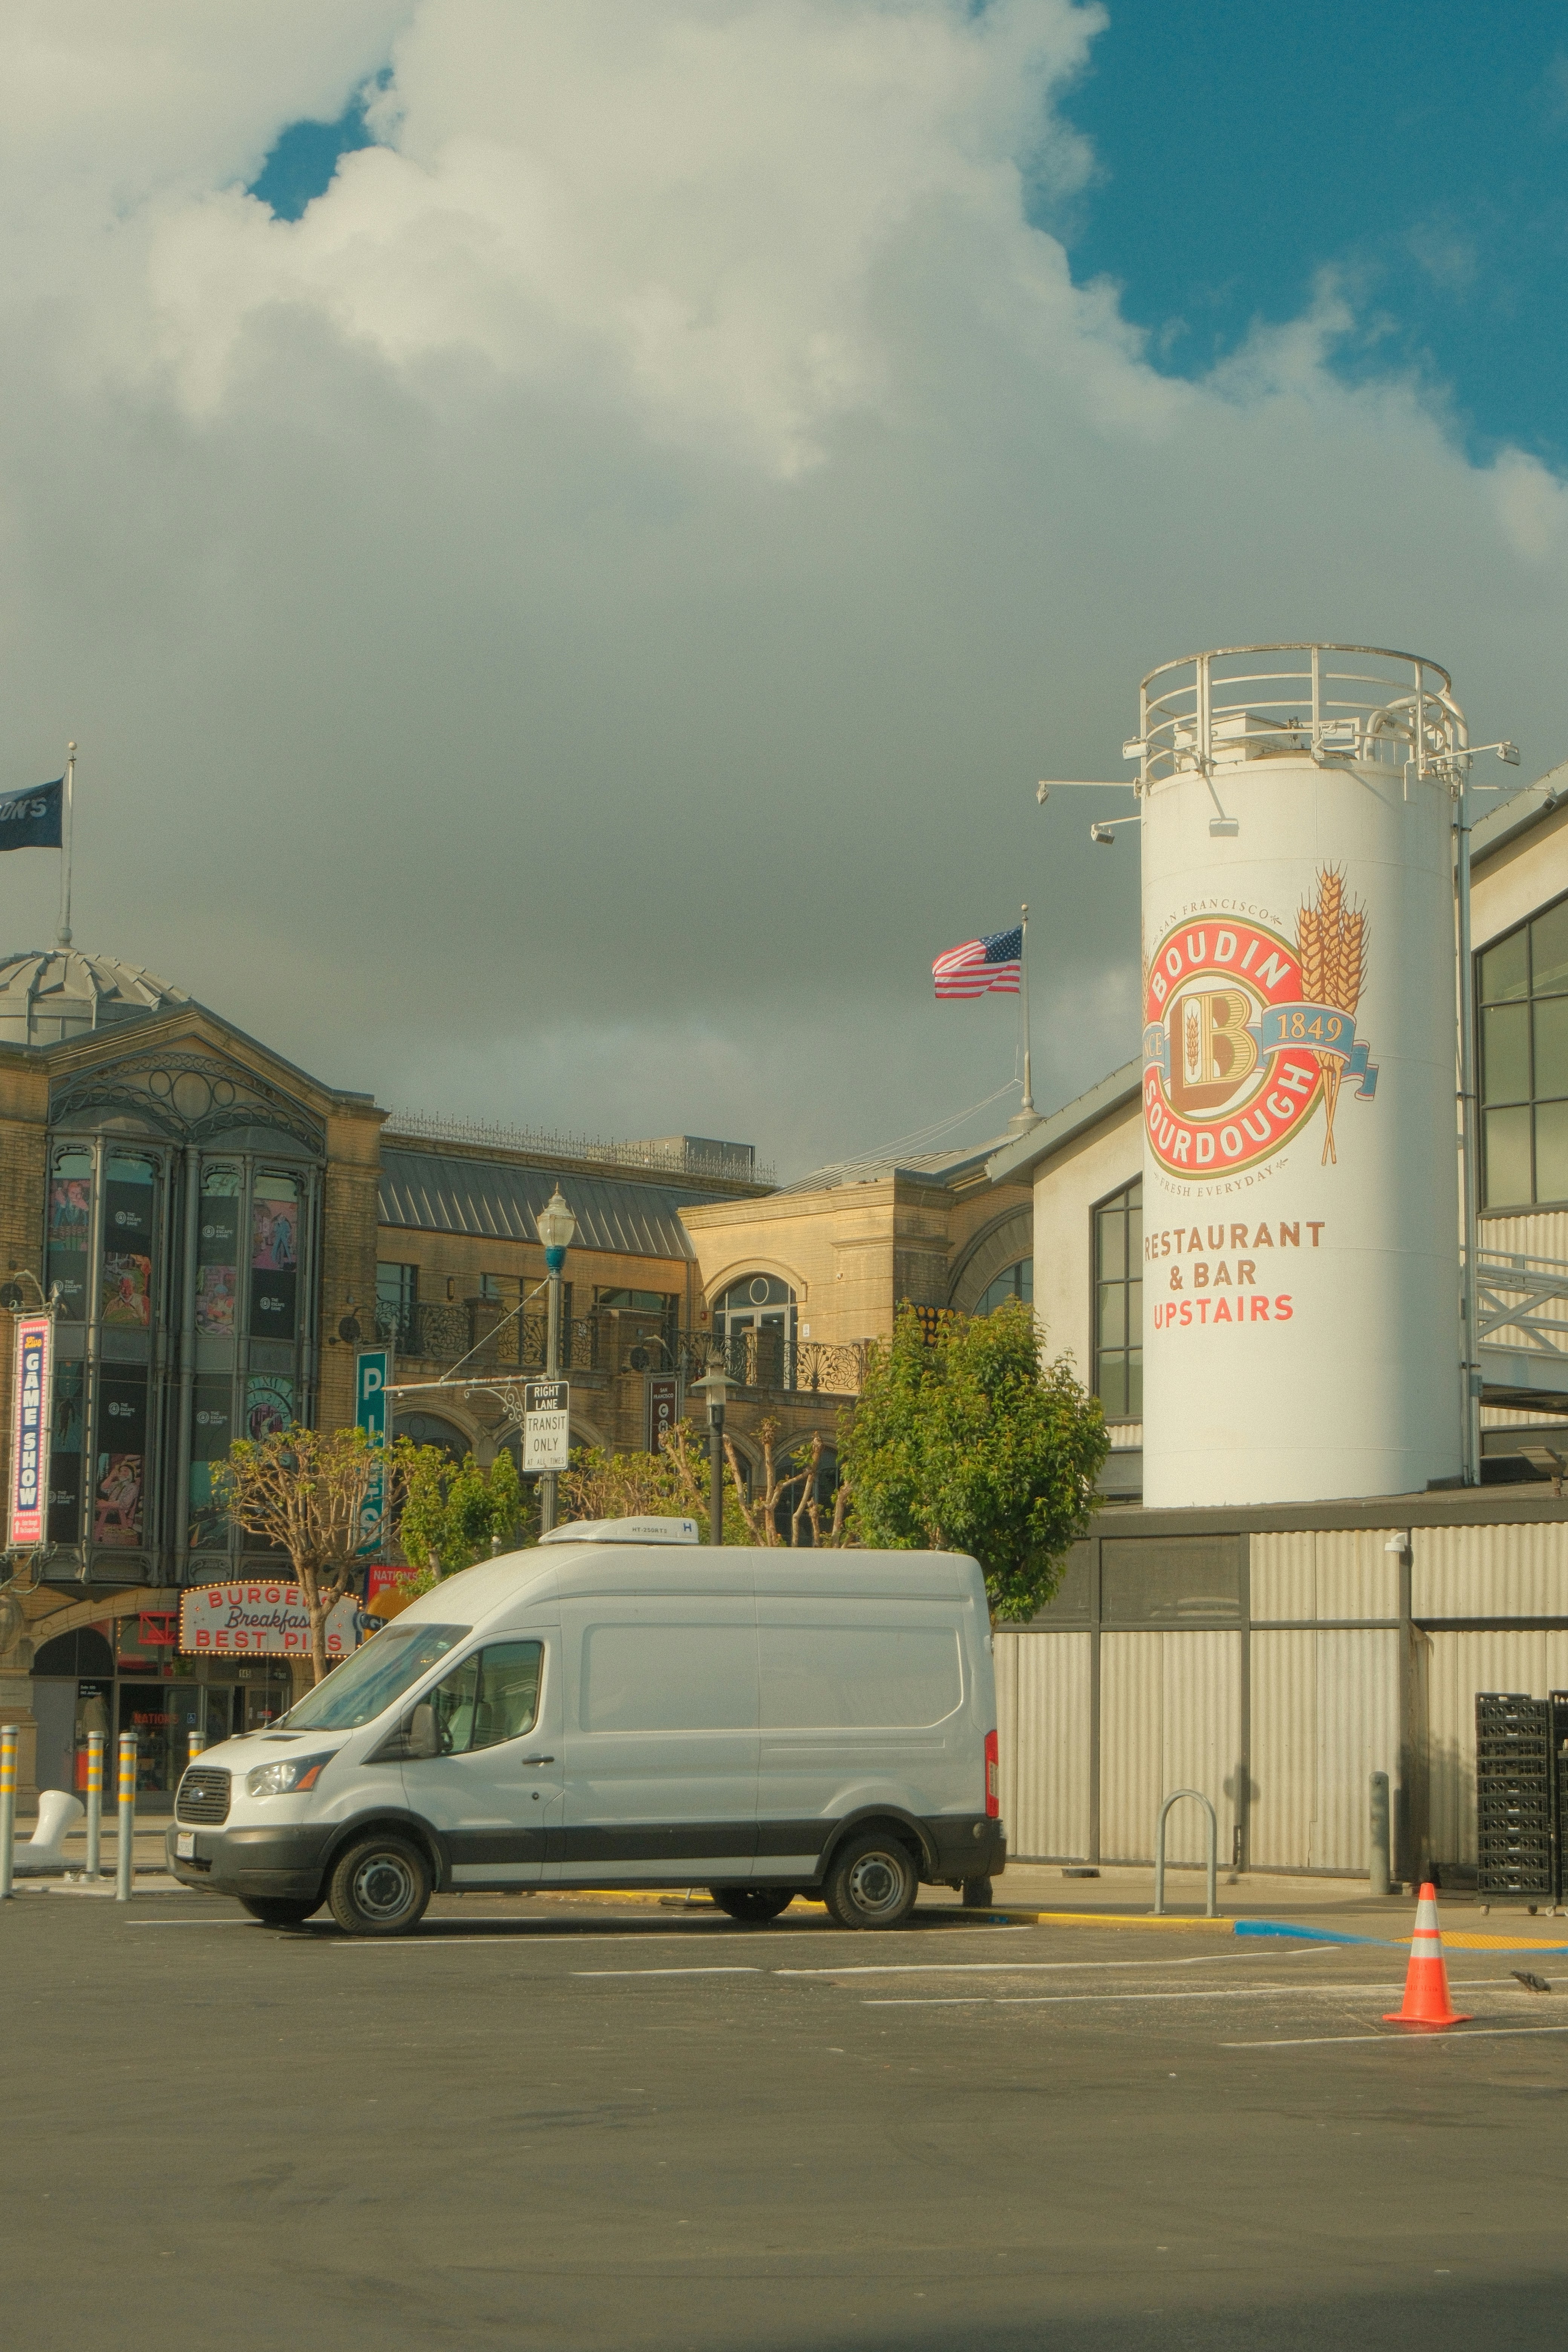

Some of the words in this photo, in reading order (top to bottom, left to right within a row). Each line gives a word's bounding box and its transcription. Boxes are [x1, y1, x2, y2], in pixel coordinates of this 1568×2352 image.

[1160, 911, 1177, 935] SAN
[1182, 899, 1269, 919] FRANCISCO
[1152, 930, 1291, 1003] BOUDIN
[1179, 988, 1257, 1093] B
[1277, 1012, 1343, 1042] 1849
[1145, 1062, 1314, 1164] SOURDOUGH
[1160, 1178, 1191, 1197] FRESH
[1197, 1165, 1273, 1197] EVERYDAY
[1145, 1221, 1325, 1261] RESTAURANT
[1170, 1265, 1184, 1291] &
[1194, 1259, 1256, 1288] BAR
[1154, 1294, 1294, 1329] UPSTAIRS
[23, 1353, 40, 1426] GAME
[534, 1385, 559, 1397] RIGHT
[536, 1398, 558, 1410] LANE
[528, 1416, 565, 1431] TRANSIT
[534, 1438, 558, 1452] ONLY
[20, 1432, 38, 1505] SHOW
[683, 1523, 692, 1532] H
[196, 1629, 266, 1648] BEST
[285, 1632, 341, 1651] PIS
